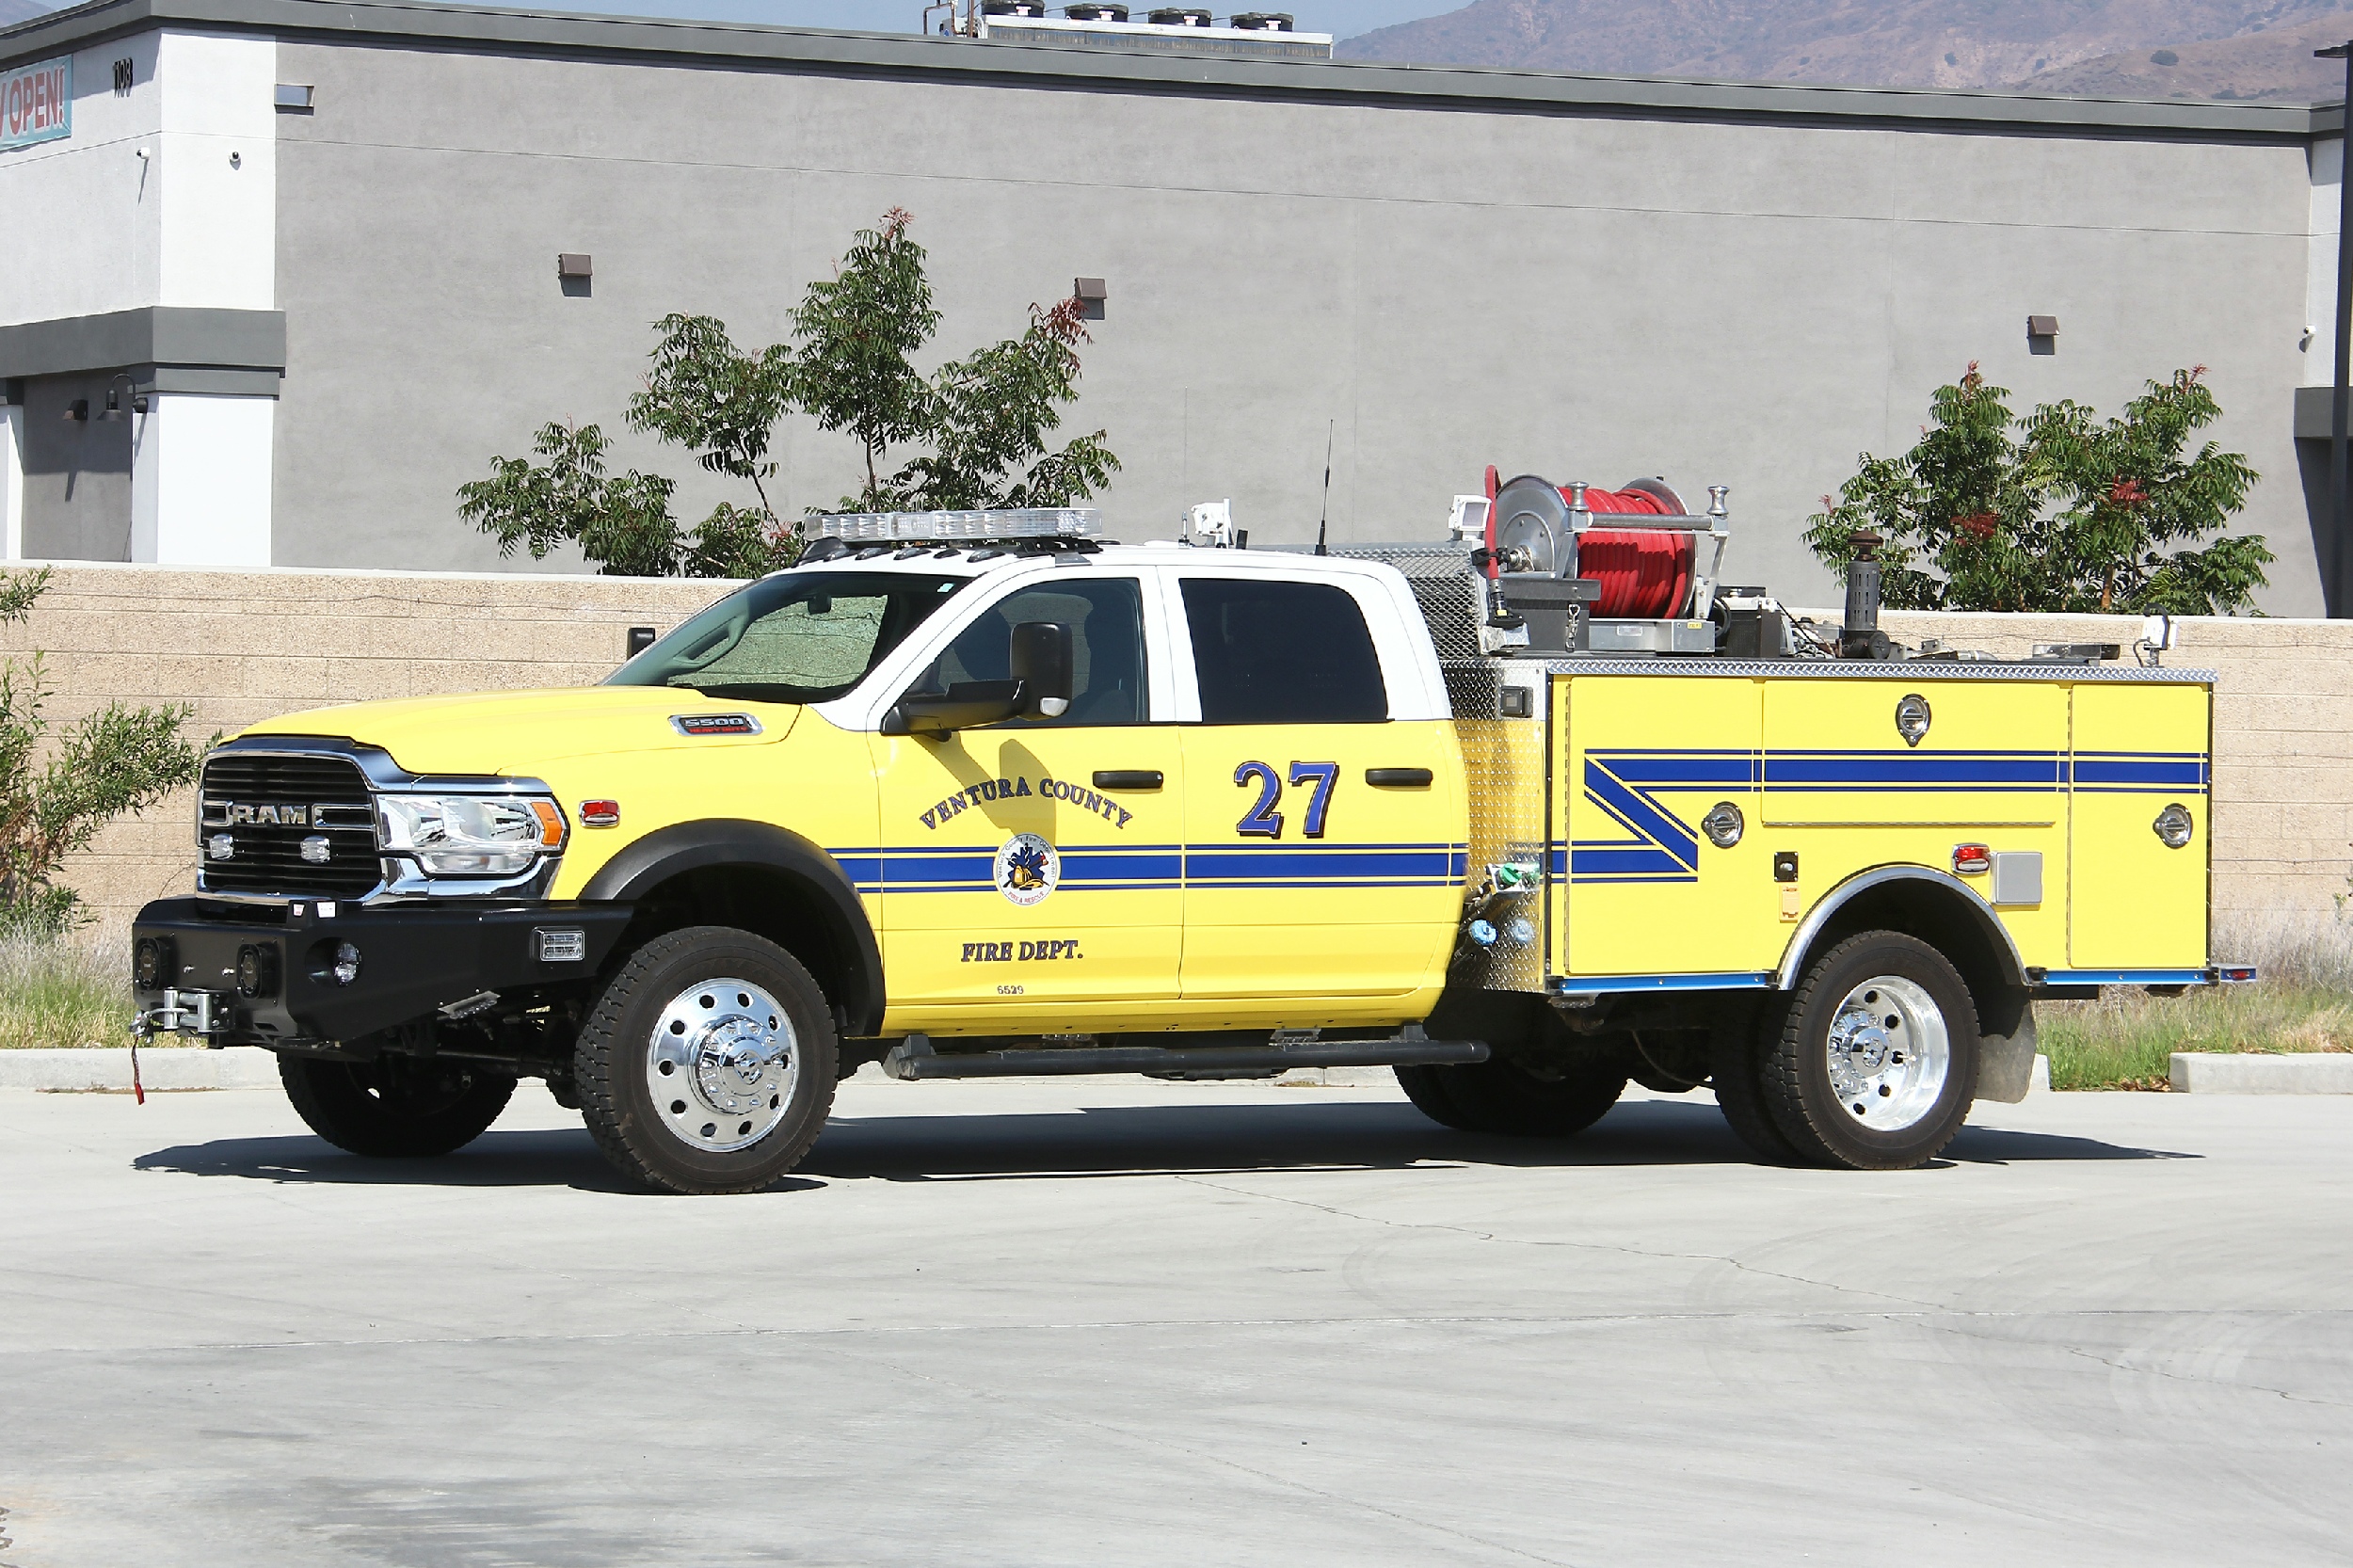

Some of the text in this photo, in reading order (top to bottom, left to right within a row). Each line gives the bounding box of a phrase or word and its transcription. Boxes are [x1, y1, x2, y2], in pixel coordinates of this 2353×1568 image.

[8, 66, 65, 136] OPEN!
[684, 717, 744, 728] 5500
[919, 776, 1133, 830] VENTURA COUNTY
[1234, 760, 1340, 840] 27
[232, 805, 307, 825] RAM
[961, 940, 1083, 962] FIRE DEPT.
[997, 984, 1024, 995] 6529
